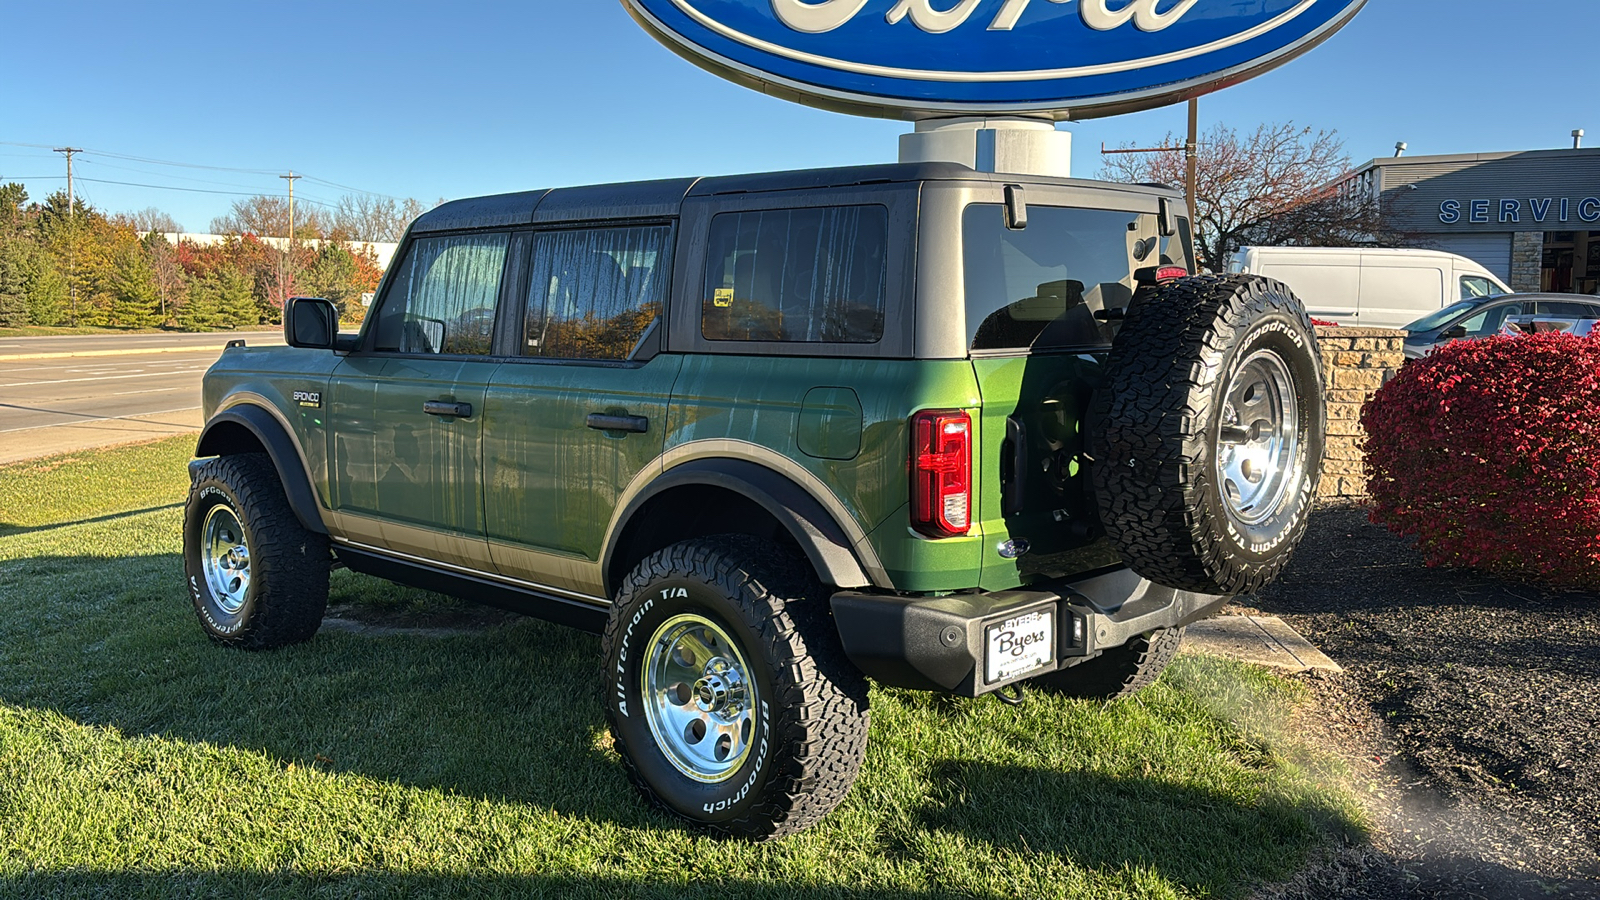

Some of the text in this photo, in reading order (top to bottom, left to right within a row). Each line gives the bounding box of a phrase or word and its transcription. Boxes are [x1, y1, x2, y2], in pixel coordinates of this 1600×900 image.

[1439, 196, 1600, 224] SERVIC
[293, 391, 320, 402] BRONCO
[1250, 474, 1311, 555] All-Terrain
[1227, 521, 1246, 550] T/A
[202, 606, 243, 634] All-Terrain
[617, 587, 688, 718] All-Terrain T/A
[993, 630, 1045, 657] Byers
[703, 699, 771, 814] BFGoodrich
